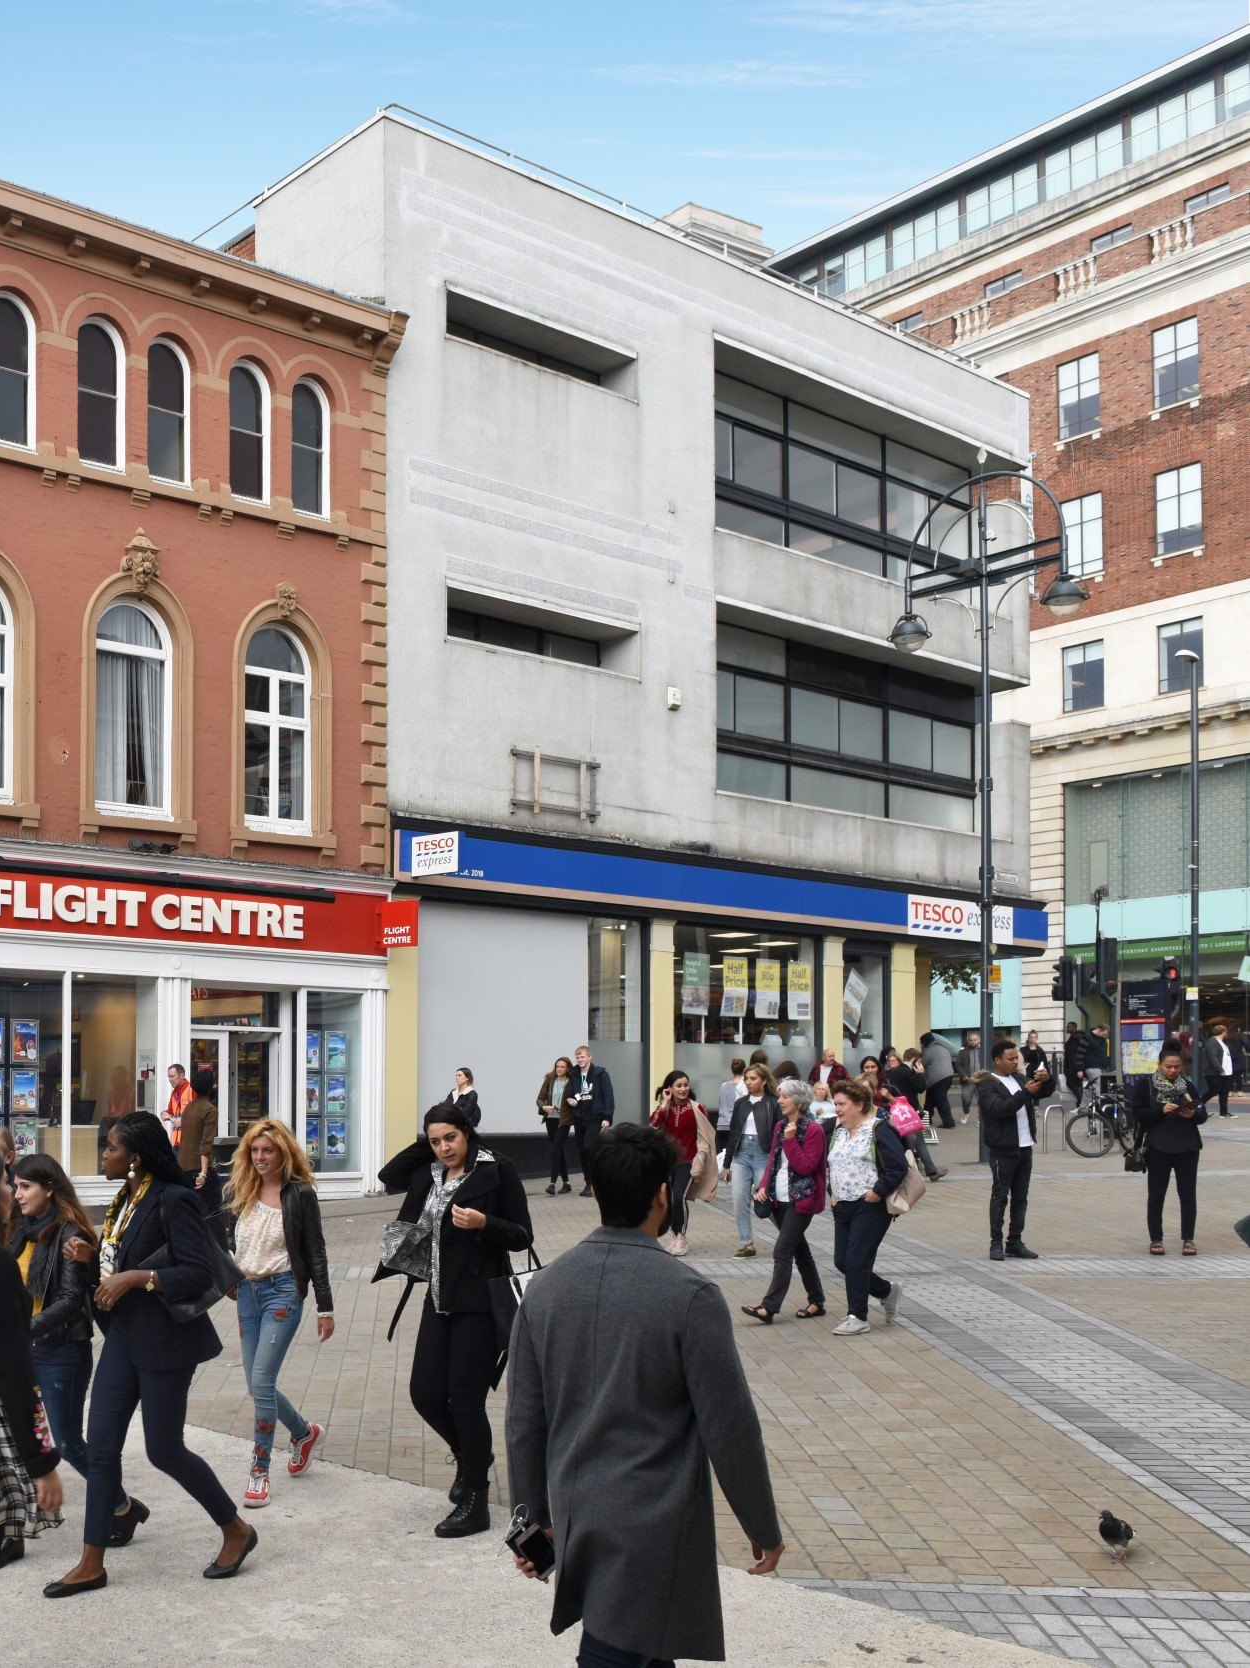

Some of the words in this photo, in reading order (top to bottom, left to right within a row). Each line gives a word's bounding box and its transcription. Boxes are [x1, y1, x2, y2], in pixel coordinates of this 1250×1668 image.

[416, 838, 454, 851] TESCO
[417, 856, 452, 869] express
[471, 869, 484, 877] 2018
[151, 894, 304, 939] CENTRE
[911, 902, 963, 924] TESCO
[967, 911, 1011, 929] exess
[384, 926, 410, 934] FLIGHT
[383, 936, 411, 944] CENTRE
[727, 964, 744, 975] Half
[792, 968, 807, 979] Half
[725, 976, 745, 987] Price
[762, 971, 775, 982] 90p
[790, 980, 809, 991] Price
